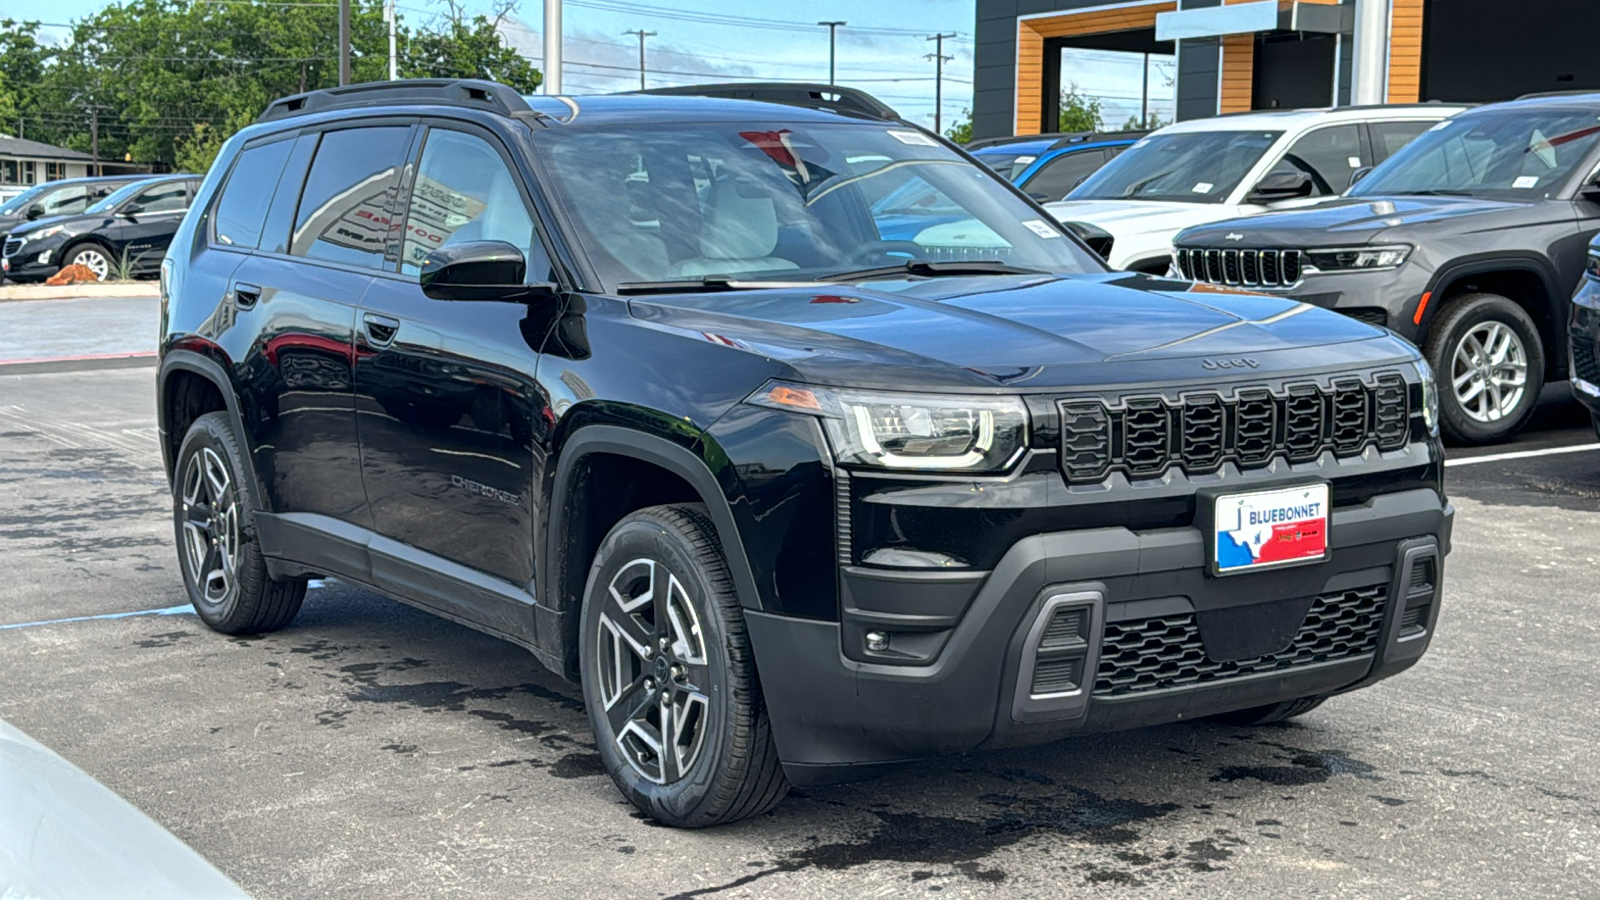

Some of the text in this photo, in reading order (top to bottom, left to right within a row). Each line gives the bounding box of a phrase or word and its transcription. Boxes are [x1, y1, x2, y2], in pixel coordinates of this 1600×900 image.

[1201, 358, 1260, 371] Jeep
[451, 474, 520, 506] CHEROKEE
[1249, 502, 1321, 525] BLUEBONNET
